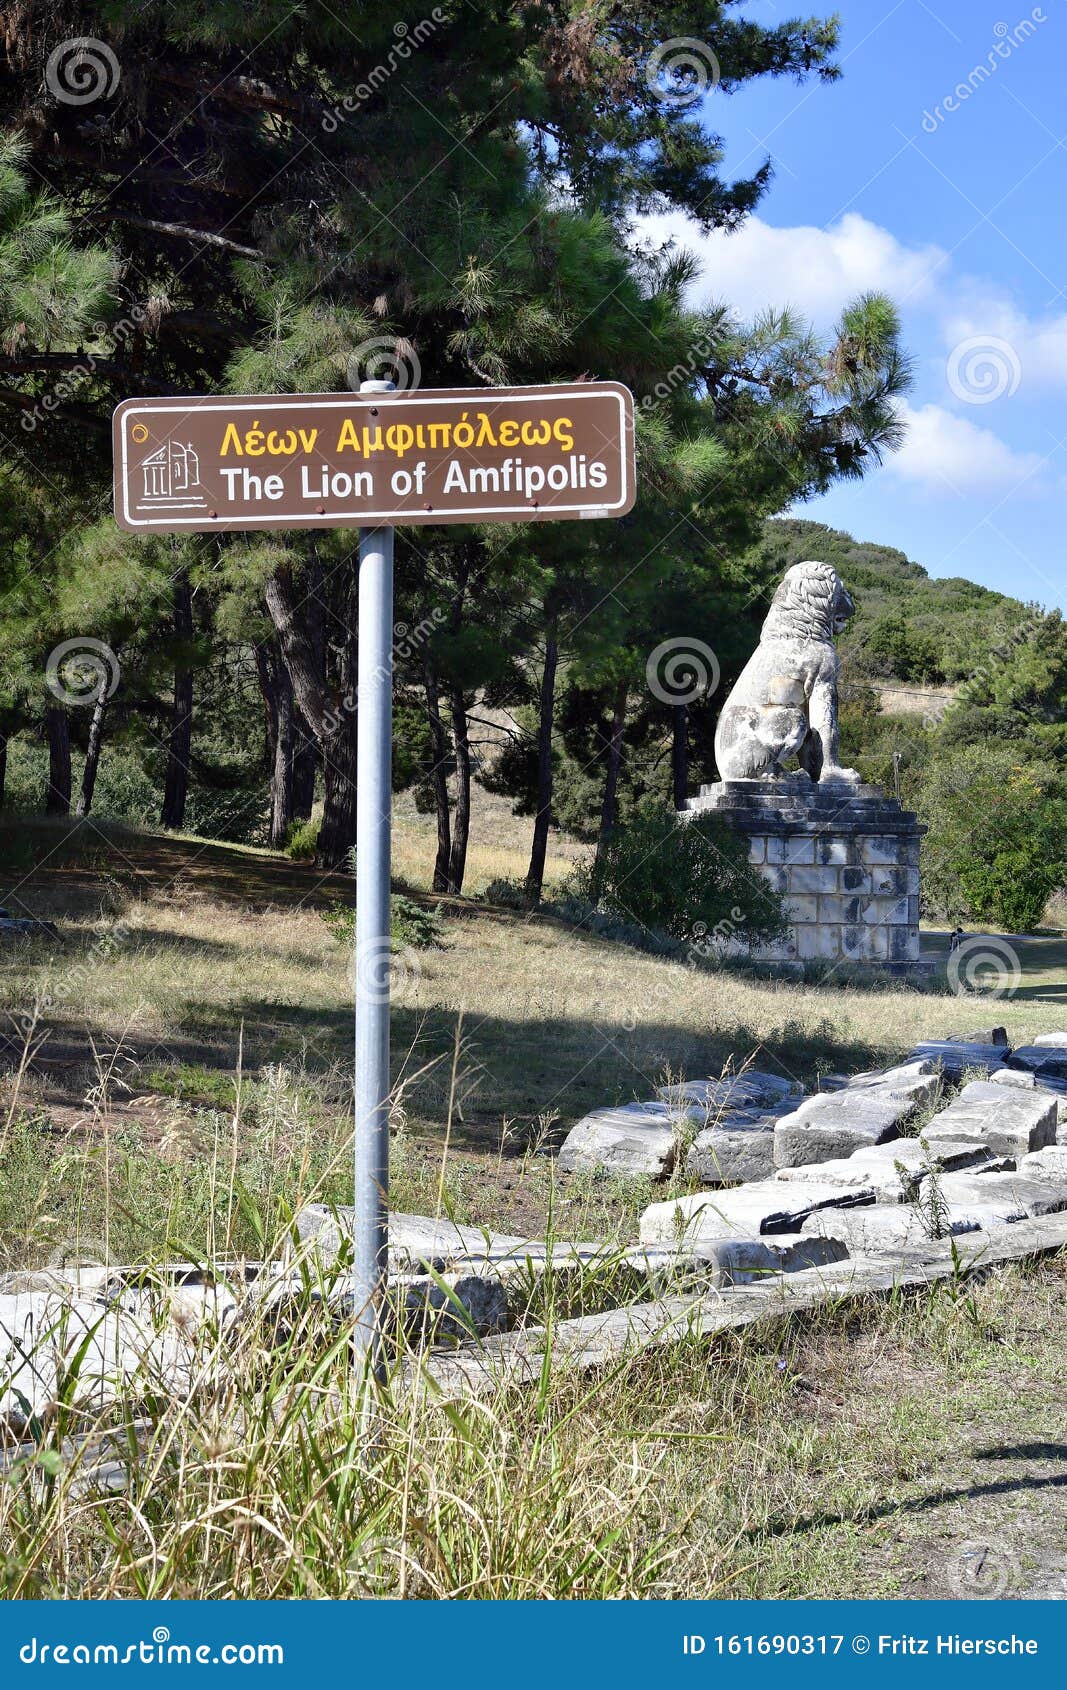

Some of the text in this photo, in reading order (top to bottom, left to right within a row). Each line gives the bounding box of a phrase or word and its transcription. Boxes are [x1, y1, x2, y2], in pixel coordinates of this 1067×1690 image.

[219, 412, 574, 458] Λέων Αμφιπόλεως
[219, 454, 608, 501] The Lion of Amfipolis
